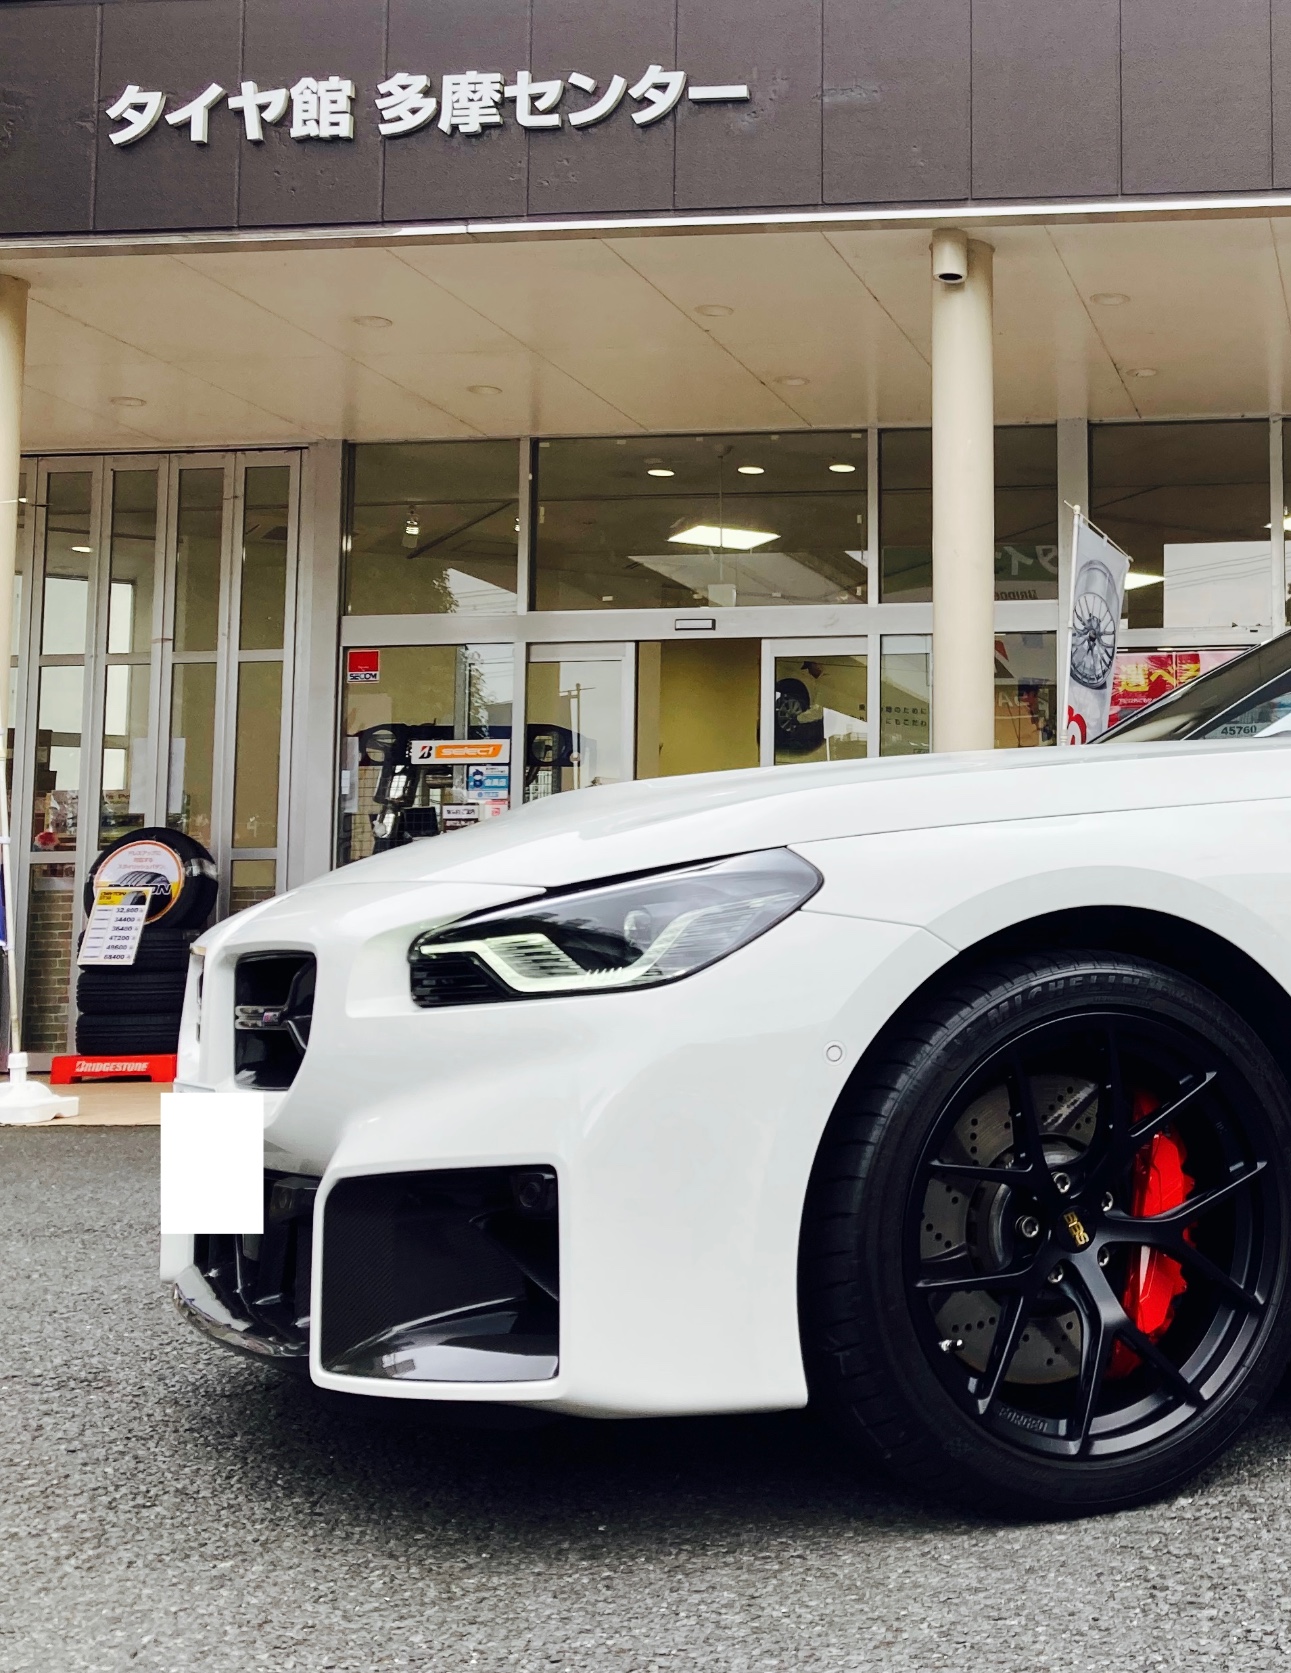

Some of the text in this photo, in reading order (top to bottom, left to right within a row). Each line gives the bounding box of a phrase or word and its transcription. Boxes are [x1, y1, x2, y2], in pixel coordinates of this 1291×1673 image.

[106, 64, 751, 146] タイヤ館 多摩センター
[349, 672, 377, 681] SECOM
[1220, 725, 1257, 735] 45760
[75, 1060, 150, 1073] BRIDGESTONE
